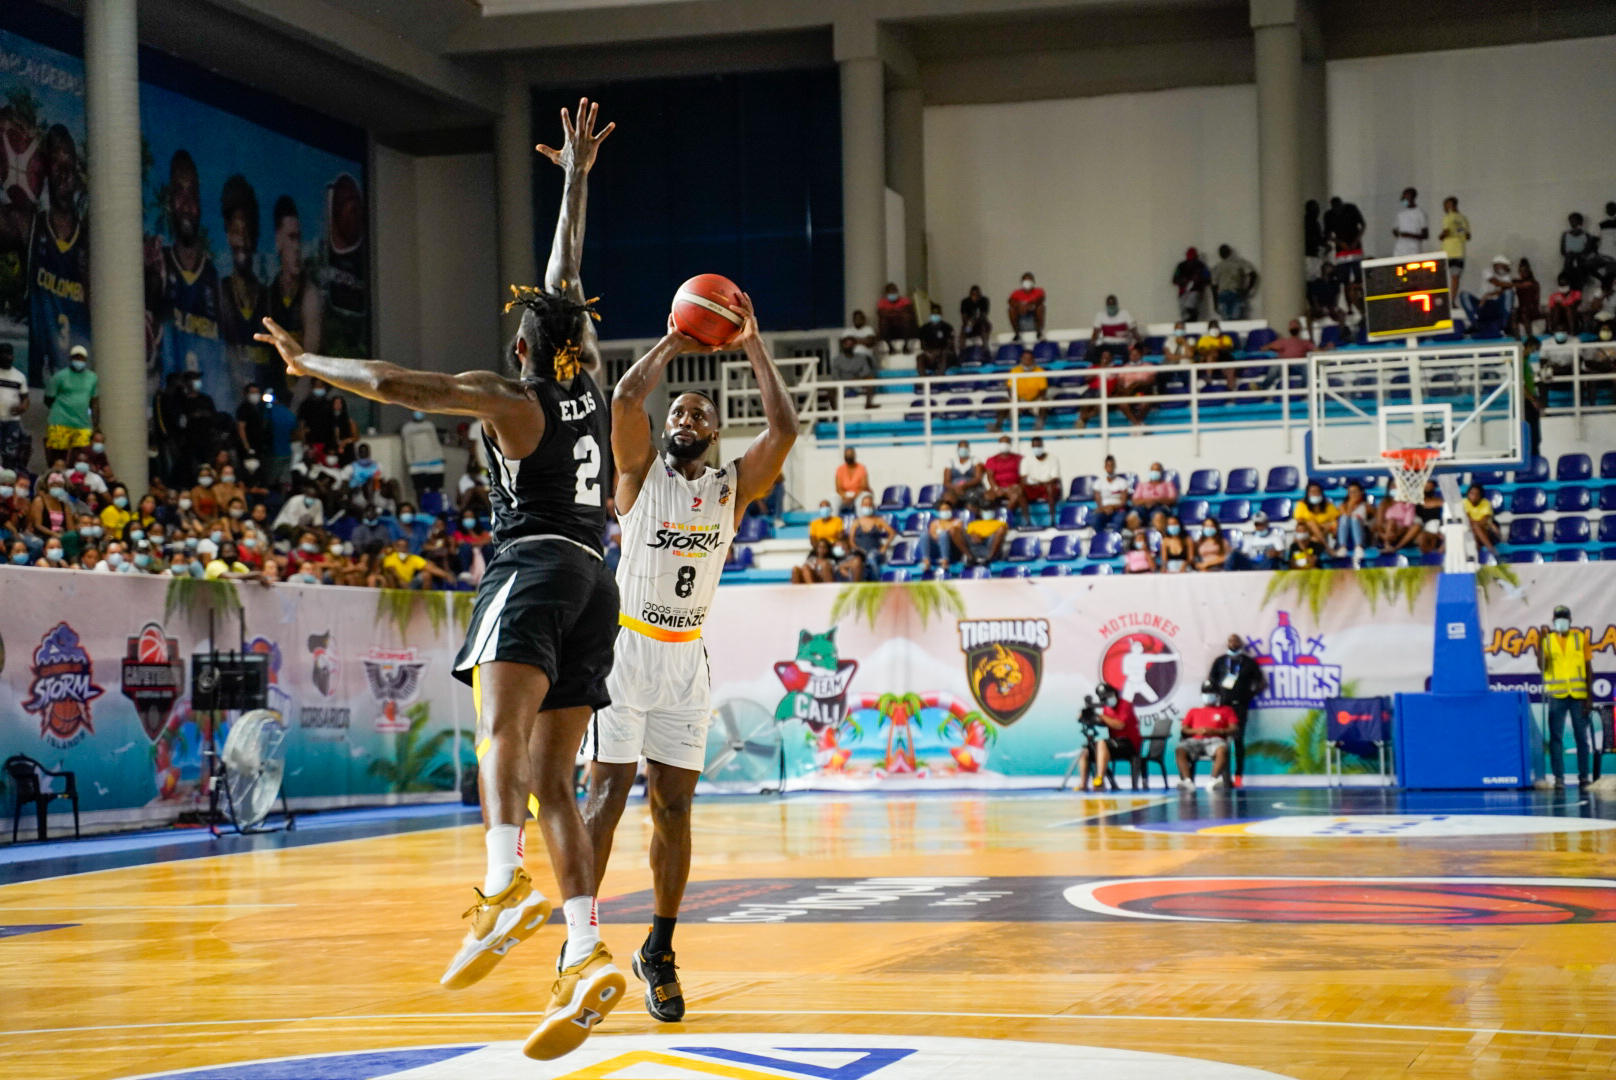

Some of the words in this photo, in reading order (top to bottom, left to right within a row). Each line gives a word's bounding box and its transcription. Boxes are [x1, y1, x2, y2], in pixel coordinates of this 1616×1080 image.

[573, 434, 601, 507] 2
[646, 530, 725, 553] STORM
[675, 565, 696, 598] 8
[959, 619, 1050, 651] TIGRILLOS
[1098, 611, 1180, 640] MOTILONES
[27, 672, 103, 711] STORM
[812, 675, 843, 695] TEAM
[795, 693, 842, 724] CALI
